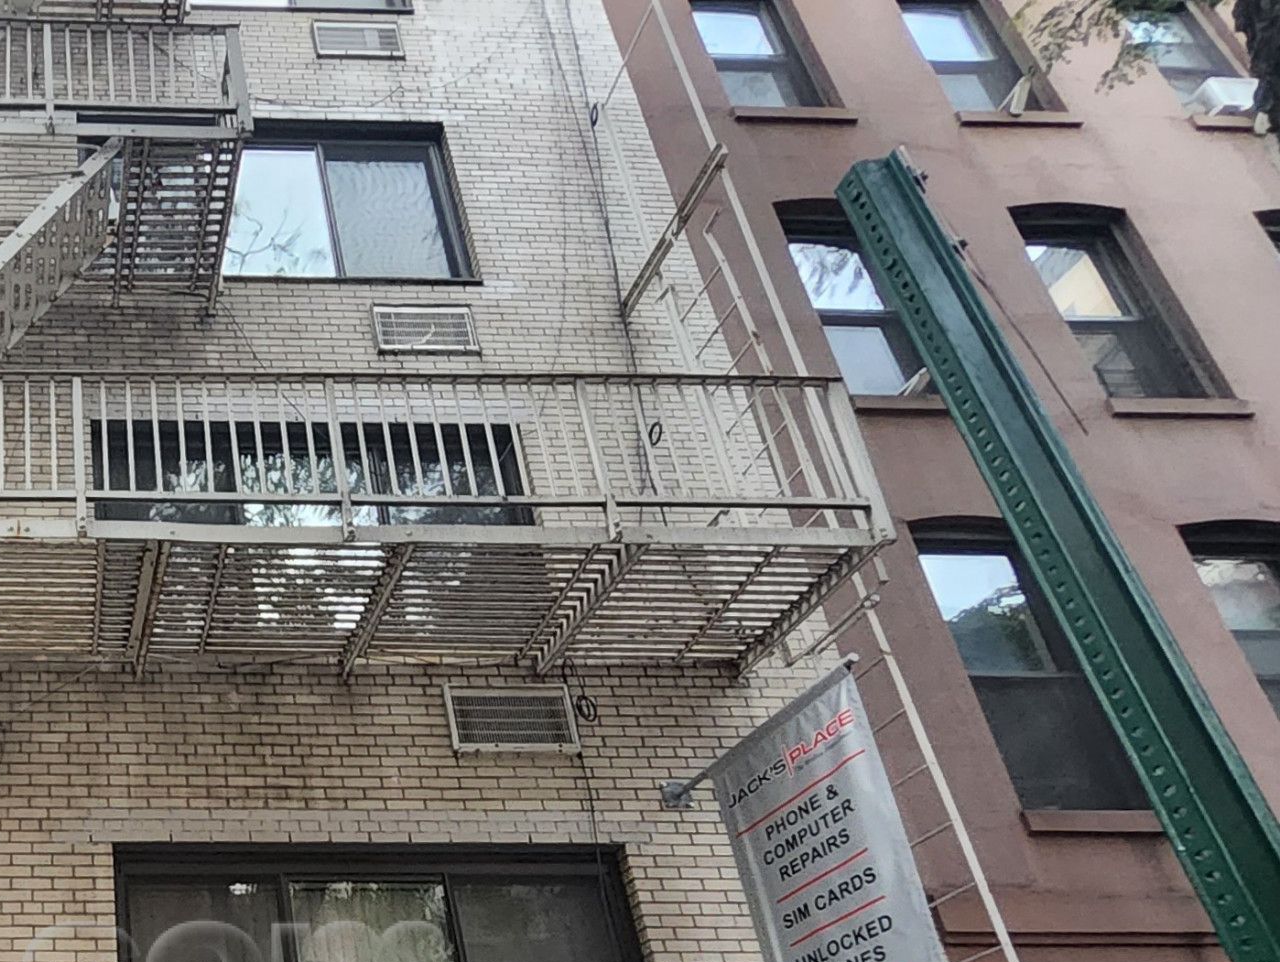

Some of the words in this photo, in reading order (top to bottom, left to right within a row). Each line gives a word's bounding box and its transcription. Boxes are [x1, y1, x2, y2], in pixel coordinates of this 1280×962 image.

[728, 758, 787, 809] JACK'S
[787, 708, 855, 766] PLACE
[762, 798, 855, 866] COMPUTER
[764, 793, 822, 842] PHONE
[825, 783, 839, 801] &
[778, 827, 851, 882] REPAIRS
[782, 903, 811, 930] SIM
[814, 866, 877, 912] CARDS
